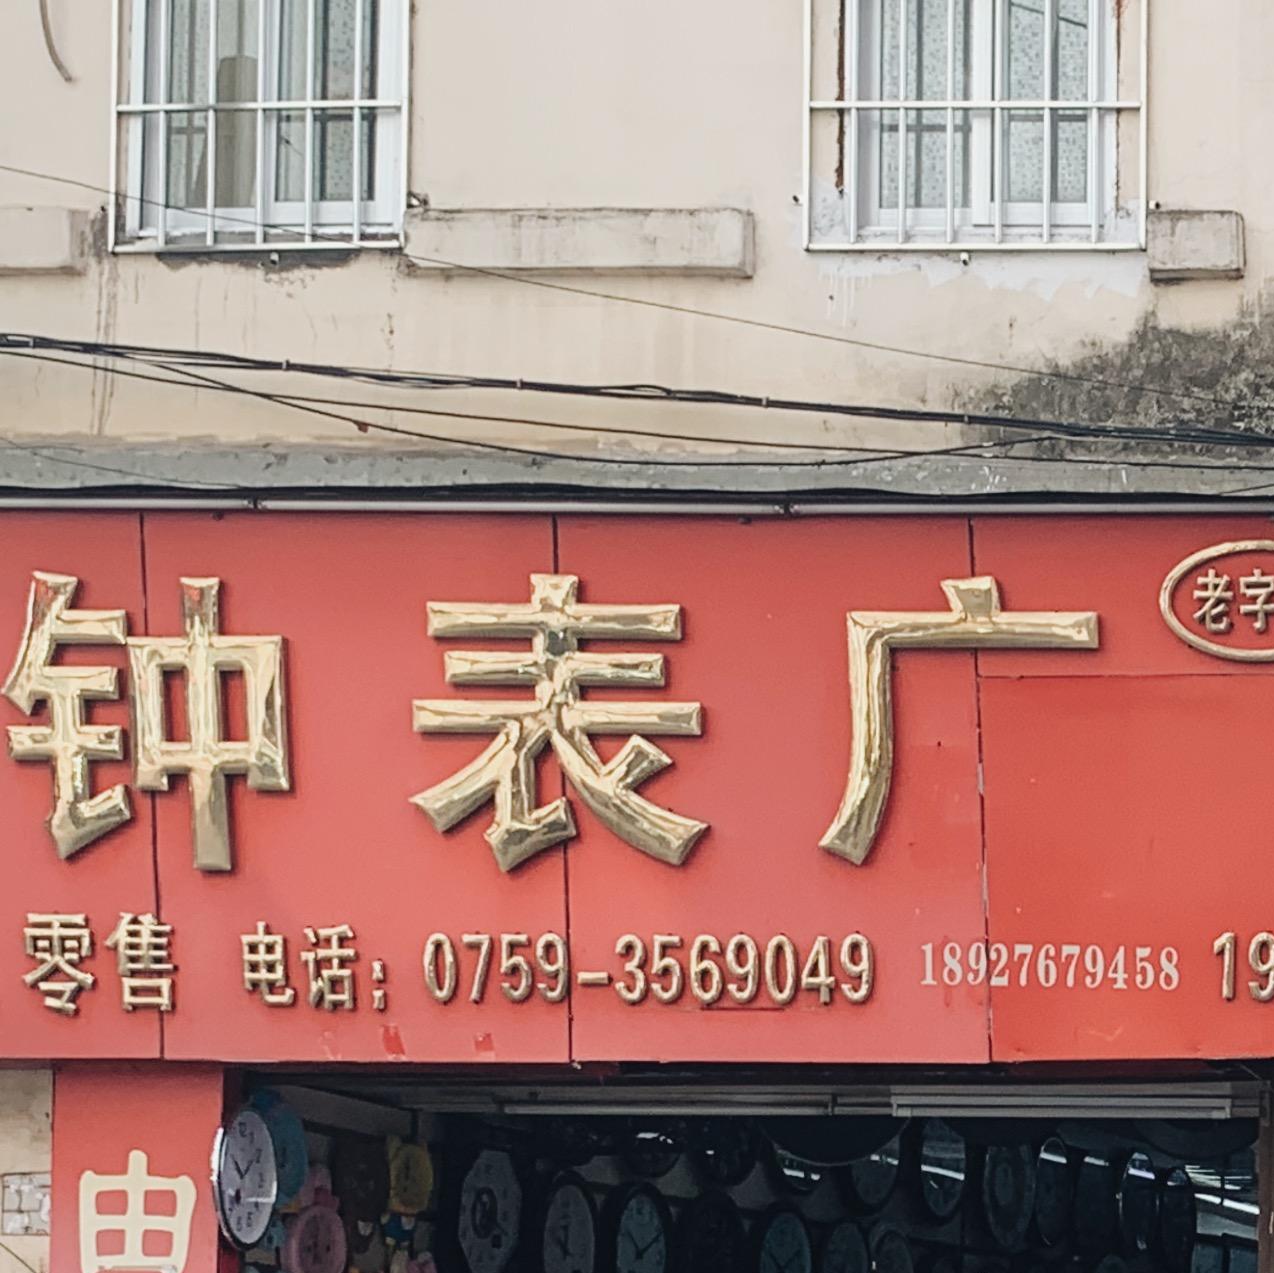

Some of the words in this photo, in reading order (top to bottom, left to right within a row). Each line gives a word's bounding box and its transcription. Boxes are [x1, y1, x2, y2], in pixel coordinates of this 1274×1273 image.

[2, 570, 1100, 873] 钟表厂
[23, 912, 177, 1016] 零售
[422, 931, 875, 1006] 0759-3569049
[920, 942, 1181, 993] 18927679458
